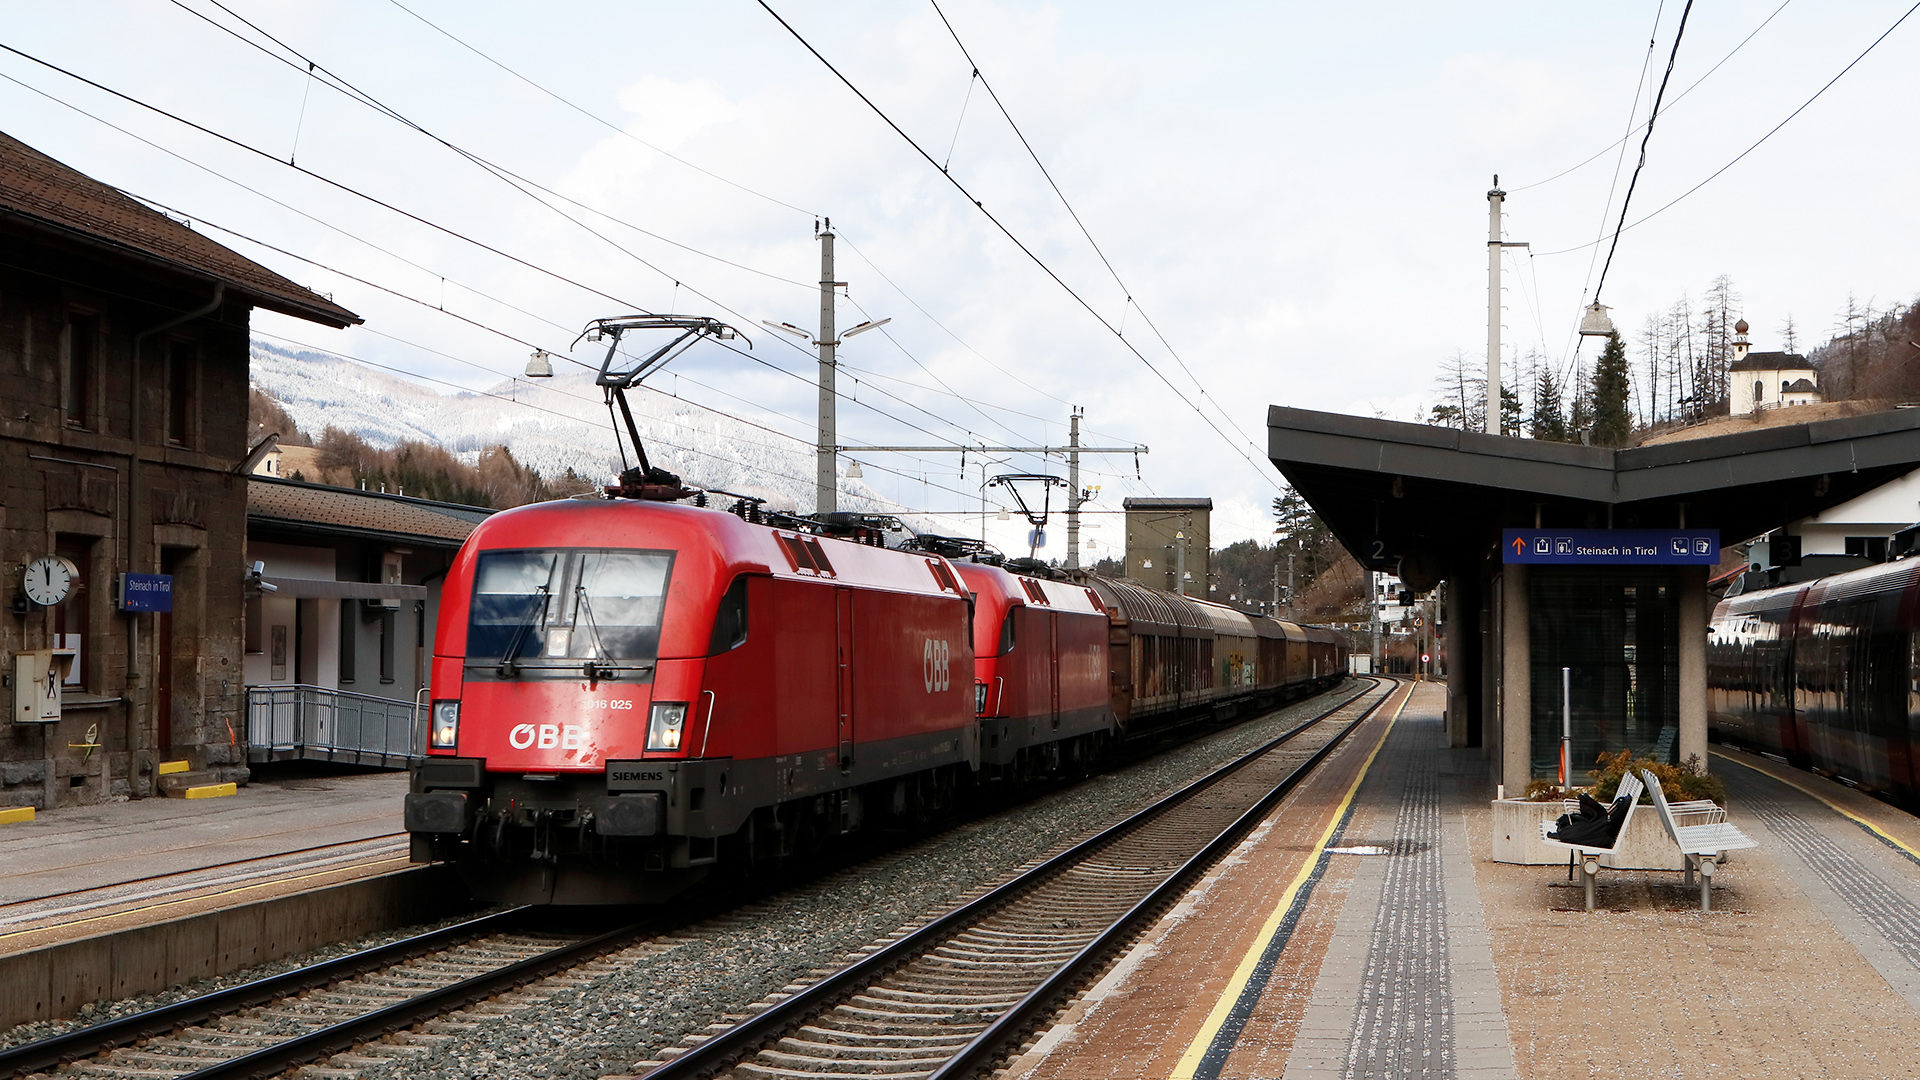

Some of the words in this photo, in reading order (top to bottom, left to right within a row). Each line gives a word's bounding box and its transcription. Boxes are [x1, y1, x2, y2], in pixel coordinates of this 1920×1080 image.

[1372, 540, 1385, 559] 2
[1576, 546, 1619, 556] Steinach
[1622, 546, 1632, 556] in
[1634, 546, 1657, 556] Tirol
[1778, 541, 1793, 561] 3
[129, 579, 152, 591] Steinach
[152, 580, 159, 592] in
[159, 580, 171, 592] Tirol
[1403, 594, 1411, 604] 2
[924, 638, 949, 694] ÖBB
[581, 699, 608, 709] 1016
[610, 699, 633, 710] 025
[509, 723, 584, 750] ÖBB
[612, 772, 663, 781] SIEMENS
